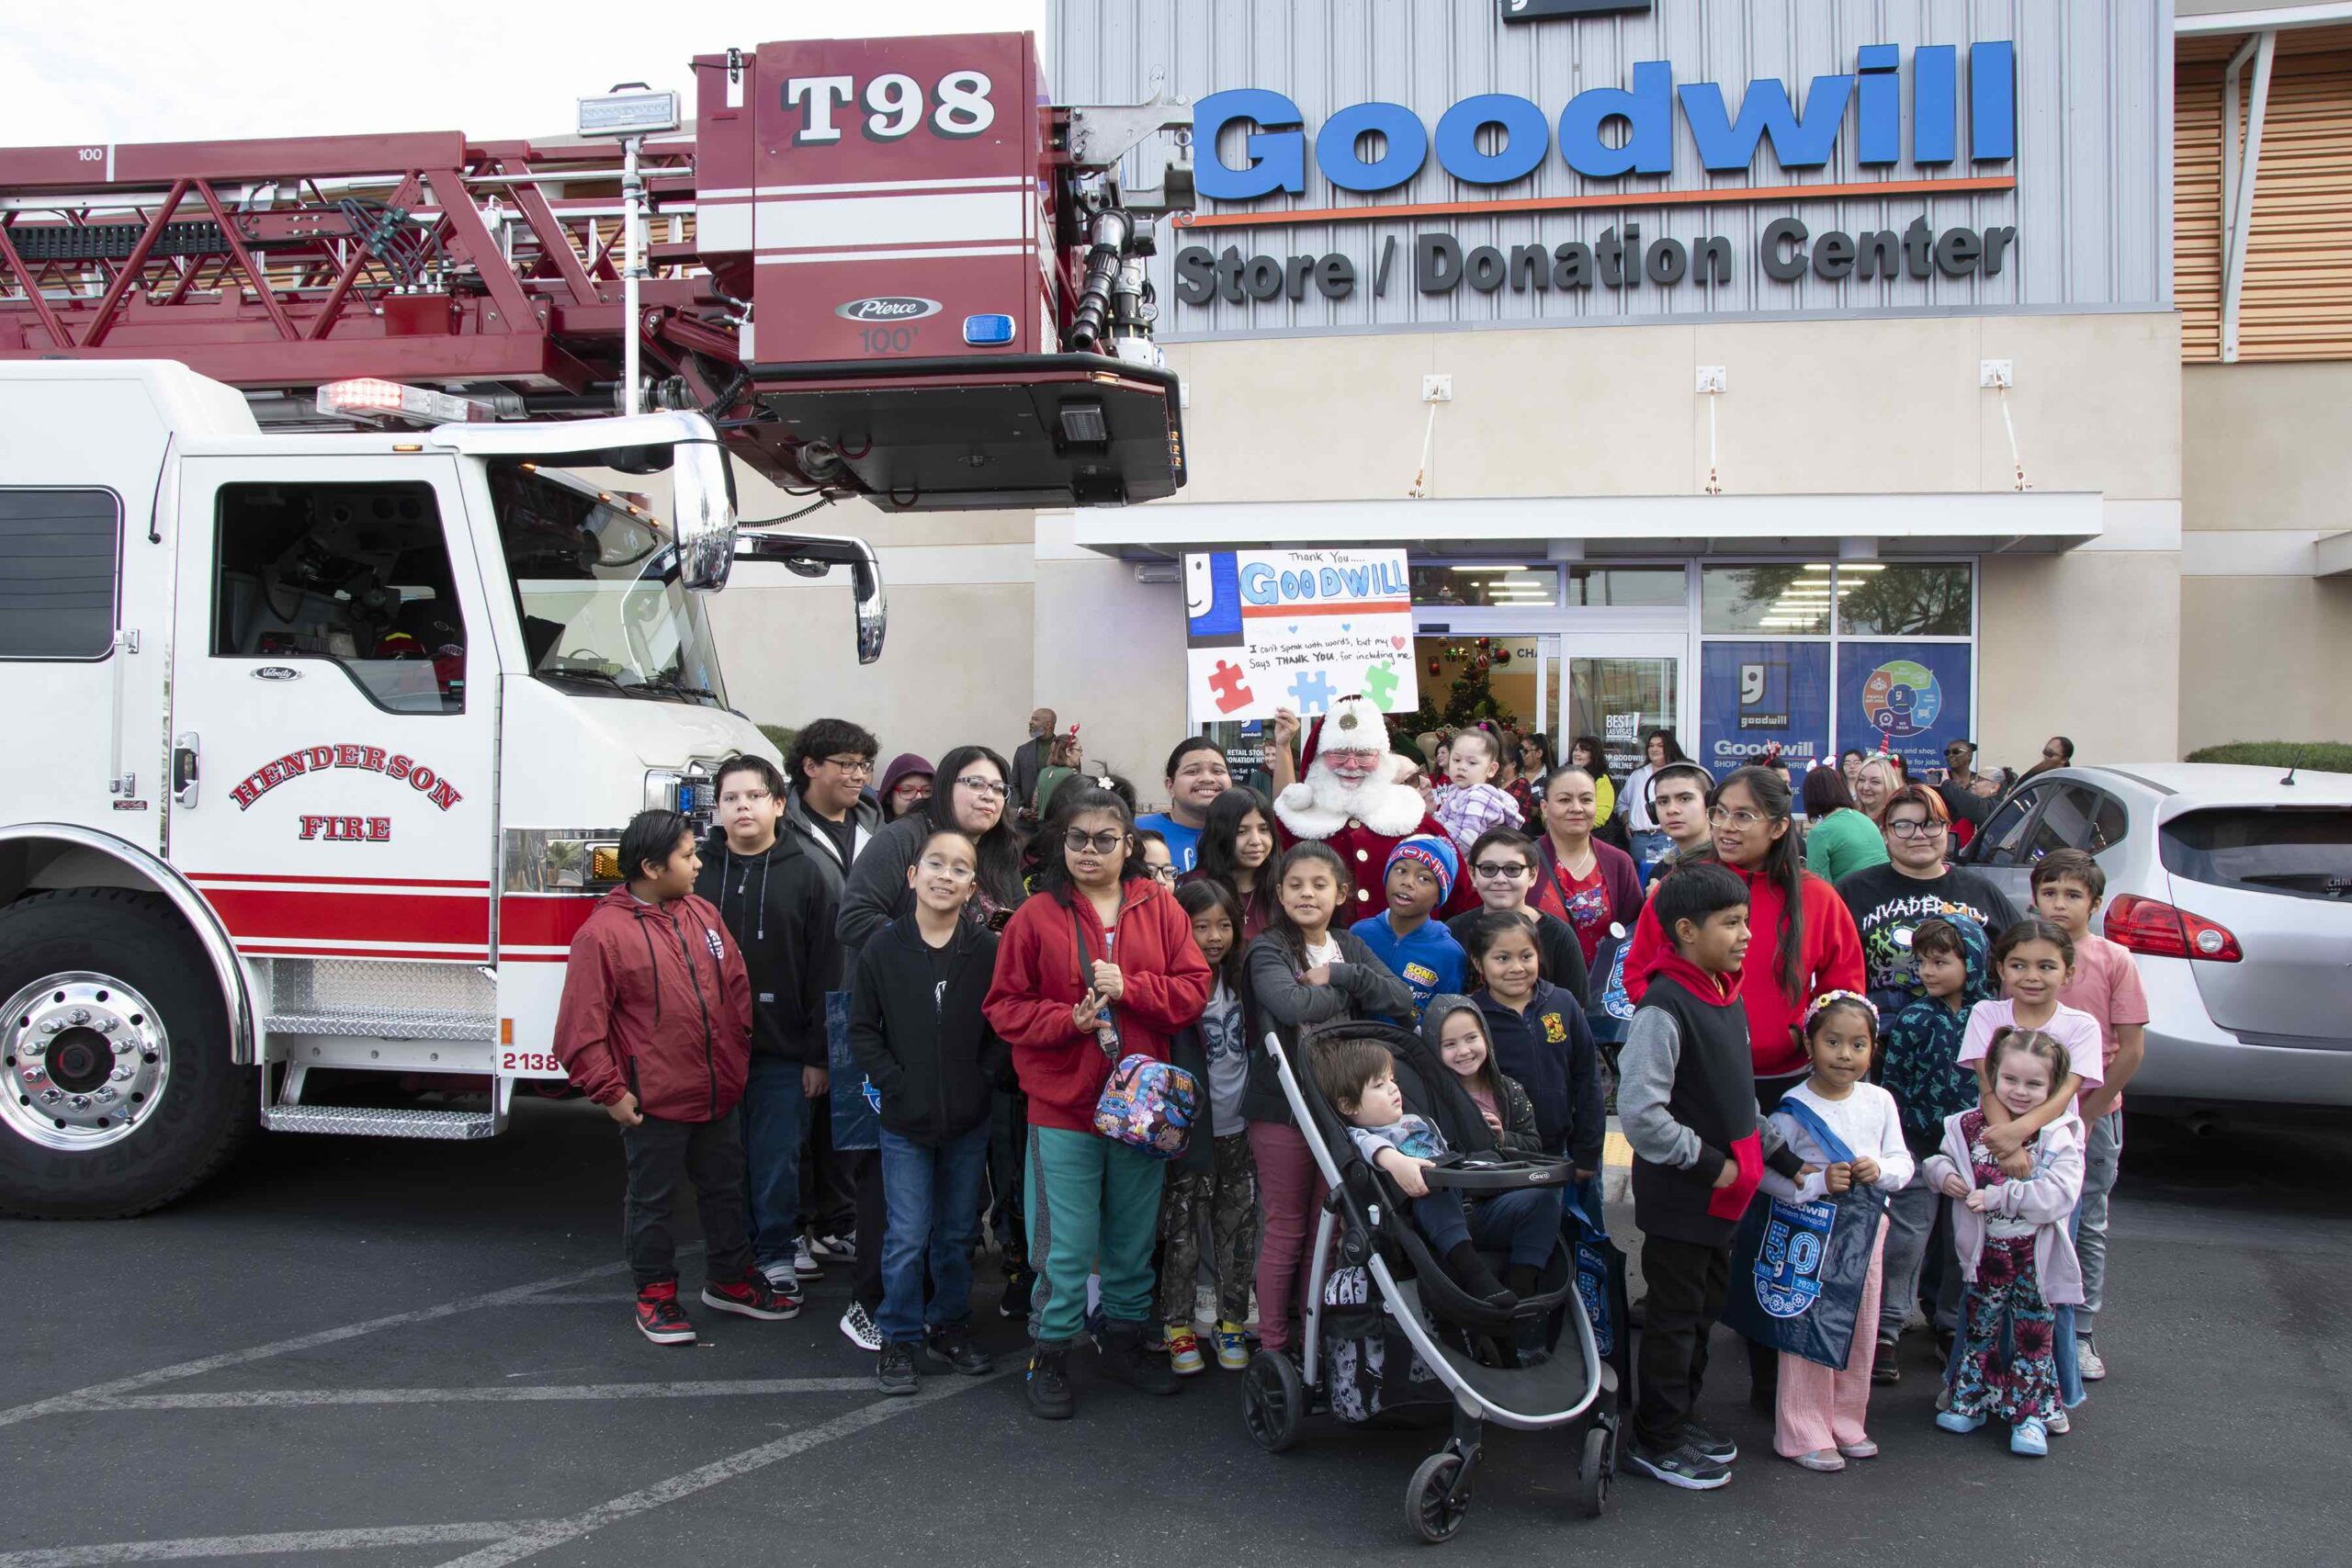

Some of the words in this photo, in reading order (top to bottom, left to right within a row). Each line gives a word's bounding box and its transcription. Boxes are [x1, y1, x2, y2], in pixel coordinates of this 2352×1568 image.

[782, 71, 996, 147] T98
[1192, 40, 2018, 201] Goodwill
[77, 148, 102, 161] 100
[1175, 243, 1355, 307] Store
[1374, 234, 1395, 298] /
[1417, 223, 1733, 294] Donation
[1760, 214, 2017, 280] Center
[858, 299, 918, 318] Pierce
[1288, 552, 1323, 561] Thank
[1240, 559, 1410, 604] GOODWILL
[1250, 644, 1257, 653] I
[1260, 643, 1278, 653] can't
[1280, 643, 1303, 653] speak
[1305, 640, 1322, 649] with
[1356, 637, 1371, 646] but
[1374, 637, 1388, 647] my
[1250, 659, 1271, 671] Says
[1275, 654, 1309, 665] THANK
[1340, 650, 1352, 661] for
[1356, 650, 1396, 665] including
[262, 667, 292, 679] Velocity
[1606, 715, 1633, 728] BEST
[1741, 716, 1787, 728] goodwill
[228, 743, 464, 812] HENDERSON
[299, 814, 391, 842] FIRE
[1407, 964, 1437, 982] SONIC
[503, 1053, 560, 1071] 2138
[1774, 1205, 1798, 1221] Southern
[1800, 1213, 1826, 1227] Nevada
[1766, 1221, 1821, 1274] 50
[1797, 1279, 1815, 1292] 2025
